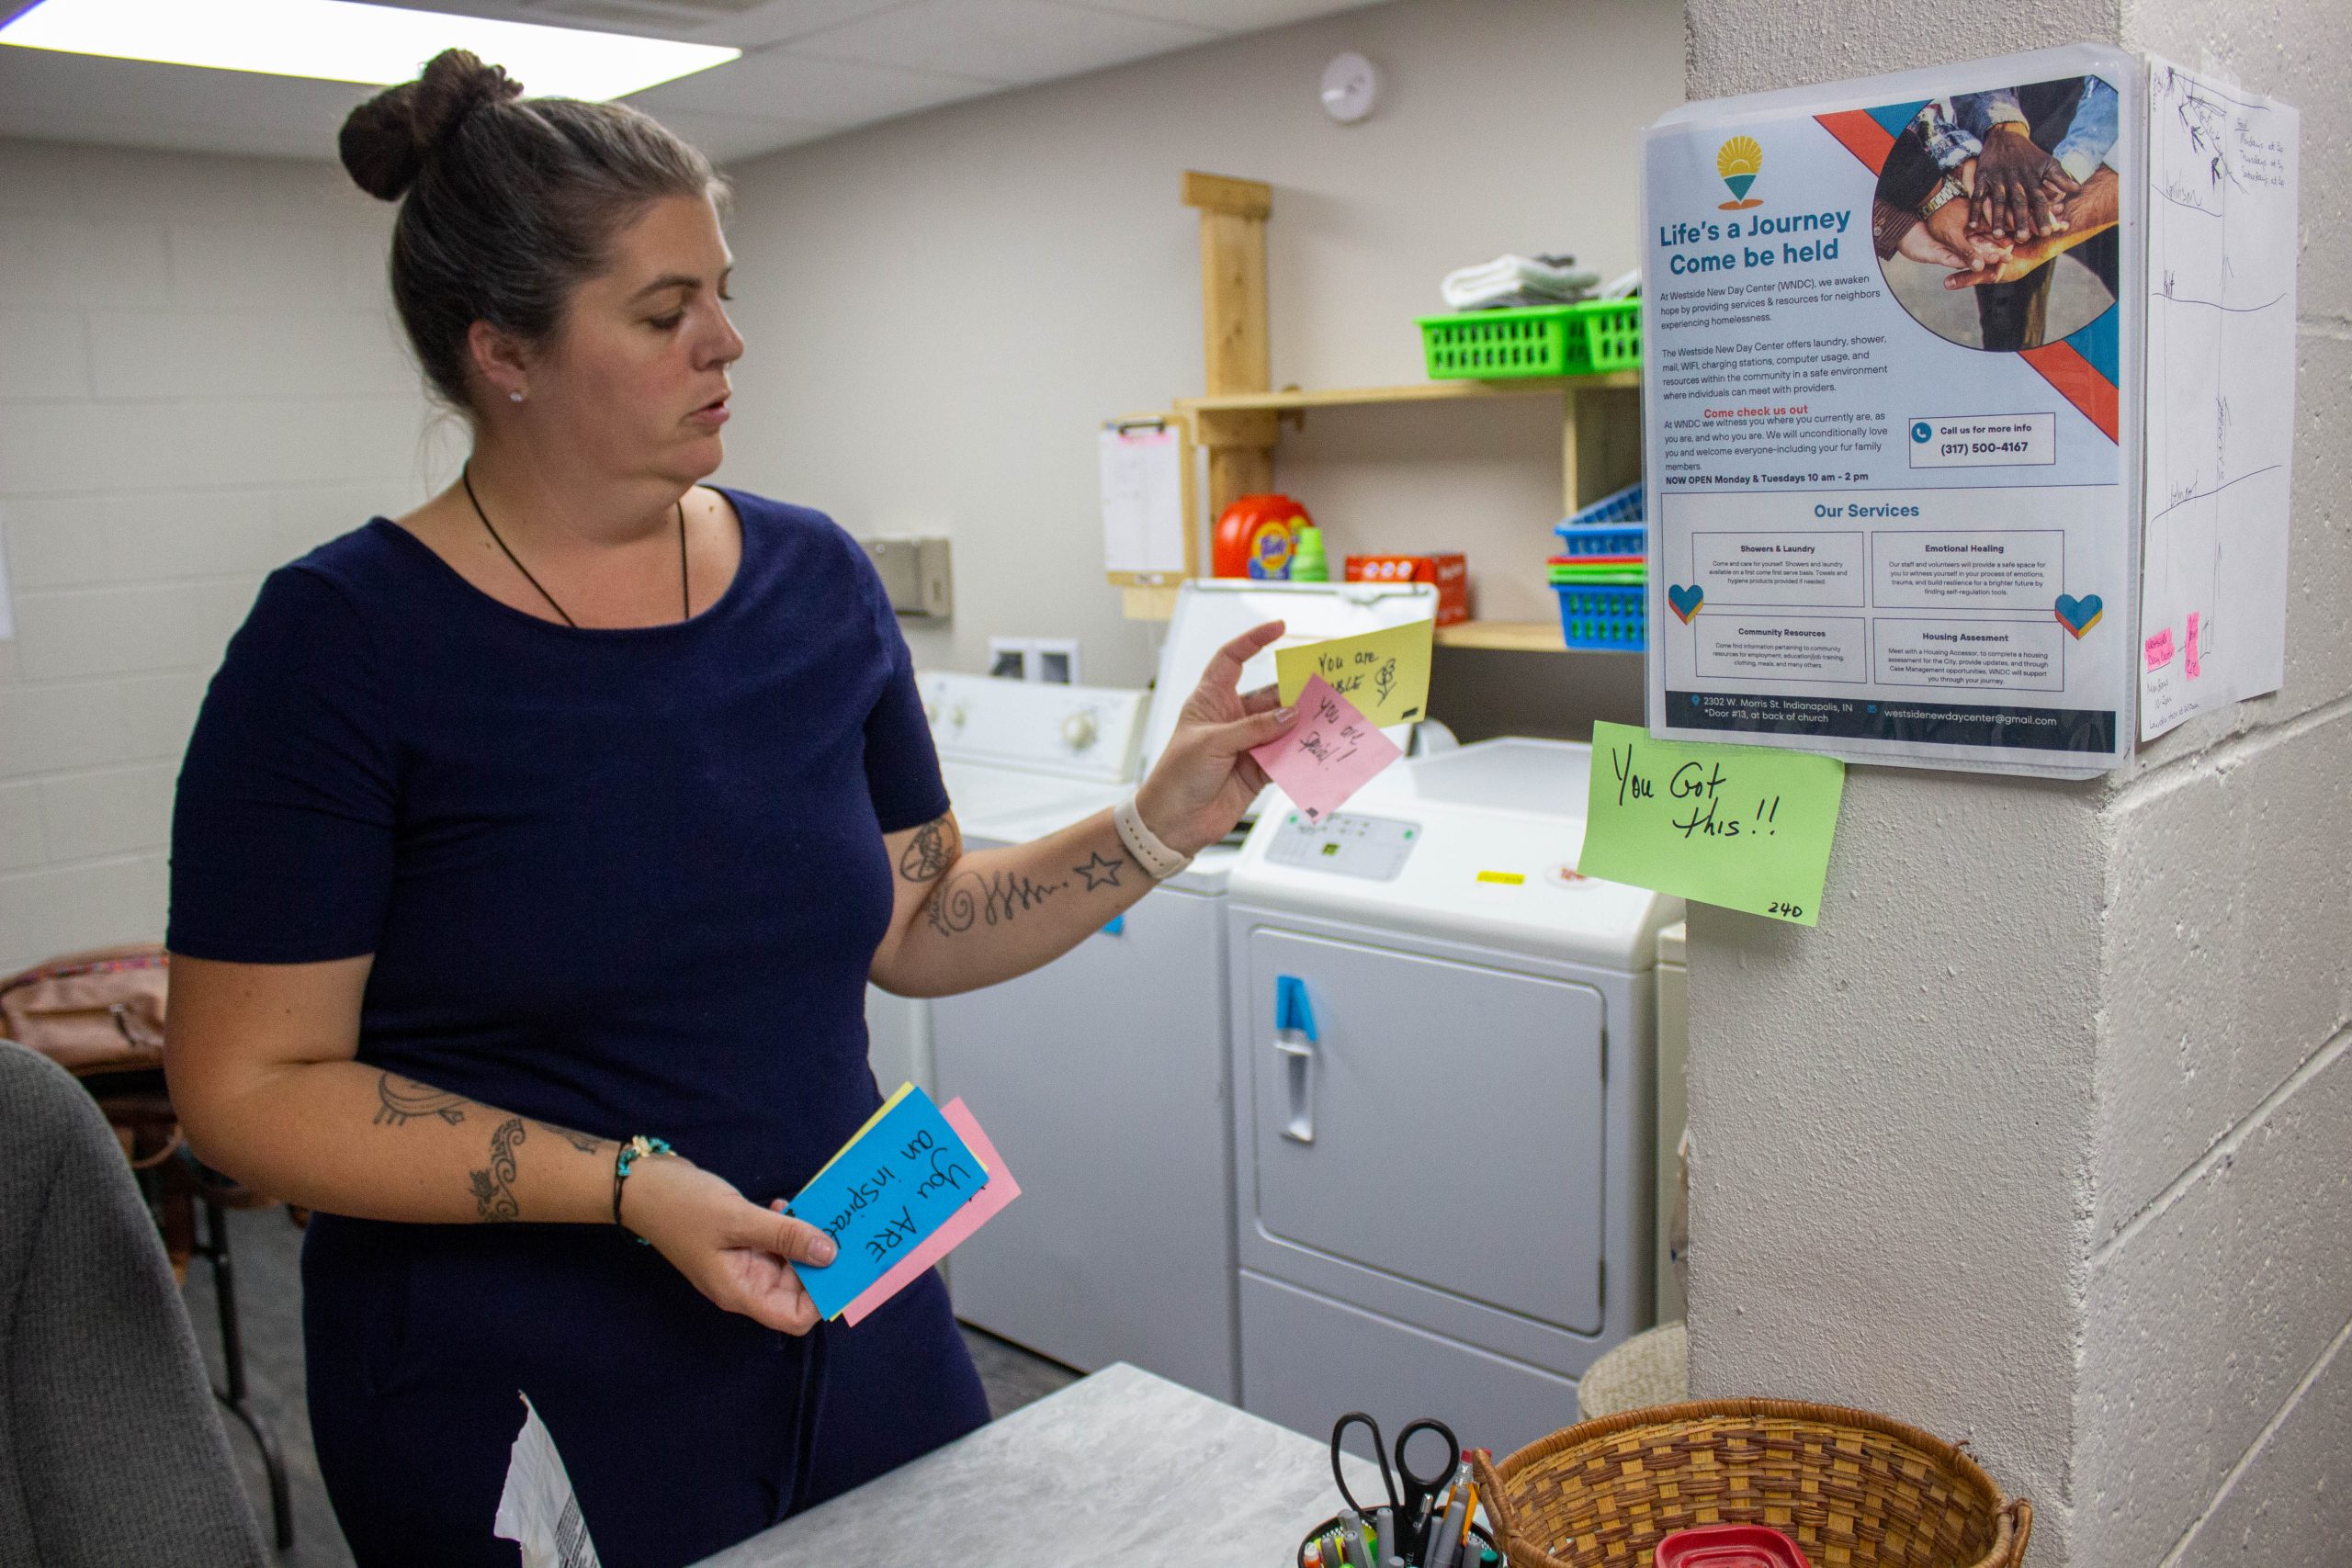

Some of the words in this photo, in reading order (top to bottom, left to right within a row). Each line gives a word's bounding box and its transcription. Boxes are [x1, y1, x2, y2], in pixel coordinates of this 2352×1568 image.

[1660, 221, 1719, 246] Life's
[1727, 222, 1740, 238] a
[1747, 210, 1850, 236] Journey
[1670, 254, 1736, 275] Come
[1744, 247, 1774, 267] be
[1782, 238, 1838, 263] held
[1660, 292, 1668, 300] At
[1669, 289, 1705, 299] Westside
[1706, 288, 1725, 296] New
[1727, 286, 1744, 296] Day
[1745, 283, 1775, 293] Center
[1834, 275, 1870, 285] awaken
[1660, 307, 1679, 316] hope
[1679, 305, 1690, 314] by
[1690, 302, 1729, 314] providing
[1730, 299, 1766, 309] services
[1766, 297, 1773, 306] &
[1775, 295, 1818, 305] resources
[1819, 293, 1832, 301] for
[1834, 289, 1881, 301] neighbors
[1661, 318, 1710, 330] experiencing
[1677, 346, 1713, 356] Westside
[1714, 344, 1734, 353] New
[1736, 344, 1753, 354] Day
[1754, 342, 1784, 351] Center
[1785, 340, 1812, 348] offers
[1701, 359, 1737, 369] charging
[1775, 355, 1818, 365] computer
[1851, 350, 1870, 359] and
[1663, 377, 1700, 386] resources
[1701, 374, 1725, 383] within
[1726, 373, 1741, 382] the
[1742, 370, 1791, 380] community
[1792, 369, 1801, 378] in
[1809, 367, 1828, 378] safe
[1830, 365, 1887, 376] environment
[1664, 391, 1687, 400] where
[1687, 389, 1729, 398] individuals
[1747, 387, 1770, 395] meet
[1771, 384, 1792, 393] with
[1704, 408, 1734, 418] Come
[1736, 406, 1770, 416] check
[1772, 407, 1786, 415] us
[1789, 404, 1808, 414] out
[1673, 419, 1701, 428] WNDC
[1715, 418, 1747, 426] witness
[1748, 418, 1765, 427] you
[1766, 415, 1794, 424] where
[1795, 416, 1812, 425] you
[1814, 412, 1853, 423] currently
[1665, 435, 1678, 445] you
[1694, 433, 1711, 442] and
[1711, 433, 1729, 441] who
[1730, 434, 1747, 442] you
[1765, 430, 1781, 439] We
[1782, 429, 1797, 438] will
[1799, 426, 1867, 437] unconditionally
[1868, 426, 1887, 435] love
[1940, 426, 1957, 434] Call
[2013, 423, 2031, 432] info
[1665, 450, 1679, 458] you
[1679, 447, 1694, 457] and
[1695, 447, 1733, 456] welcome
[1817, 445, 1838, 454] your
[1839, 442, 1852, 451] fur
[1854, 441, 1882, 452] family
[1940, 443, 1968, 456] (317)
[1972, 441, 2028, 452] 500-4167
[1666, 476, 1687, 484] NOW
[1688, 475, 1713, 484] OPEN
[1713, 475, 1750, 484] Monday
[1752, 474, 1758, 482] &
[1760, 473, 1805, 483] Tuesdays
[1807, 472, 1818, 481] 10
[1844, 471, 1850, 480] 2
[1852, 473, 1869, 482] pm
[1815, 504, 1842, 517] Our
[1848, 504, 1918, 517] Services
[1782, 545, 1815, 554] Laundry
[1970, 545, 2004, 553] Healing
[1738, 627, 1782, 637] Community
[1783, 628, 1826, 637] Resources
[1922, 633, 1958, 642] Housing
[1959, 633, 2008, 641] Assesment
[1318, 652, 1343, 676] You
[1355, 650, 1378, 665] are
[1703, 696, 1724, 705] 2302
[1739, 698, 1767, 707] Morris
[1841, 703, 1852, 711] IN
[1761, 711, 1784, 720] back
[1785, 712, 1795, 720] of
[1797, 713, 1828, 722] church
[1884, 710, 2057, 725] westsidenewdaycenter@gmail.com
[1612, 743, 1654, 807] You
[1669, 761, 1726, 798] Got
[900, 1129, 934, 1160] an
[916, 1146, 971, 1199] You
[865, 1205, 917, 1264] ARE
